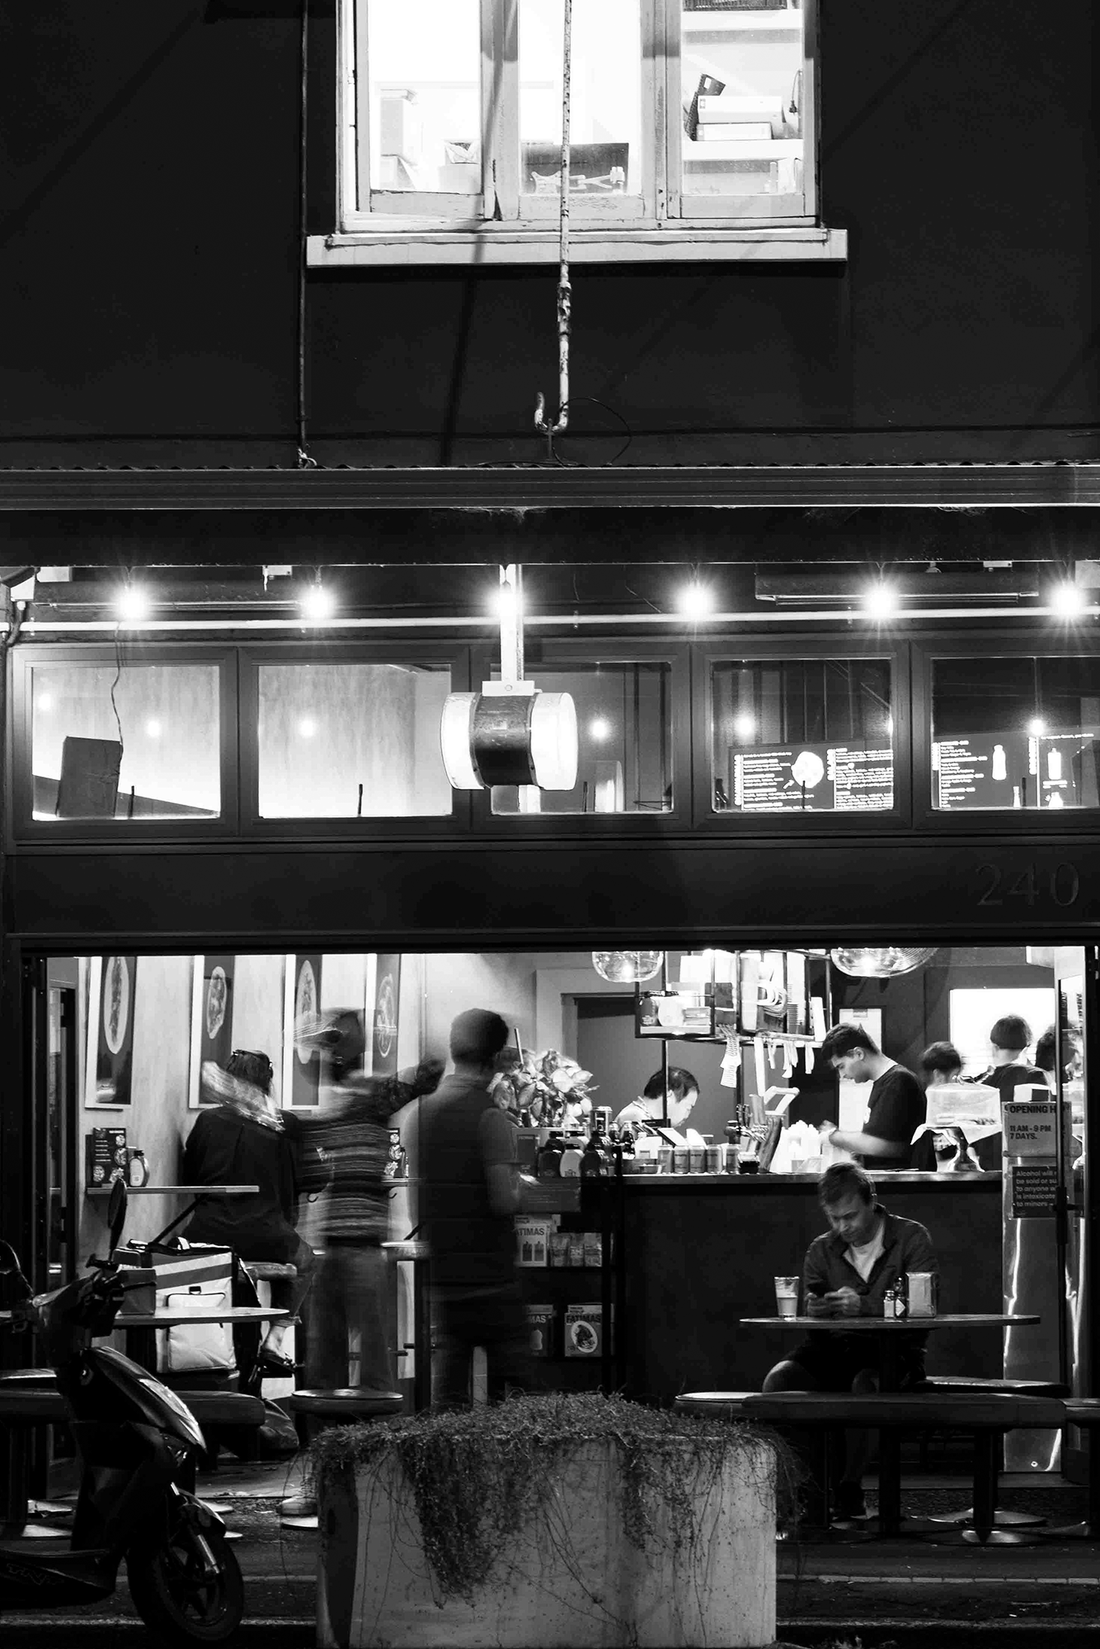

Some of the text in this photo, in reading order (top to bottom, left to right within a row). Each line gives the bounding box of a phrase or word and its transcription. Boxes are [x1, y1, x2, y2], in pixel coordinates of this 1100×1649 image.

[975, 862, 1080, 906] 240
[1010, 1105, 1048, 1113] OPENING
[516, 1228, 545, 1236] ATIMAS
[566, 1315, 601, 1323] FATIMAS
